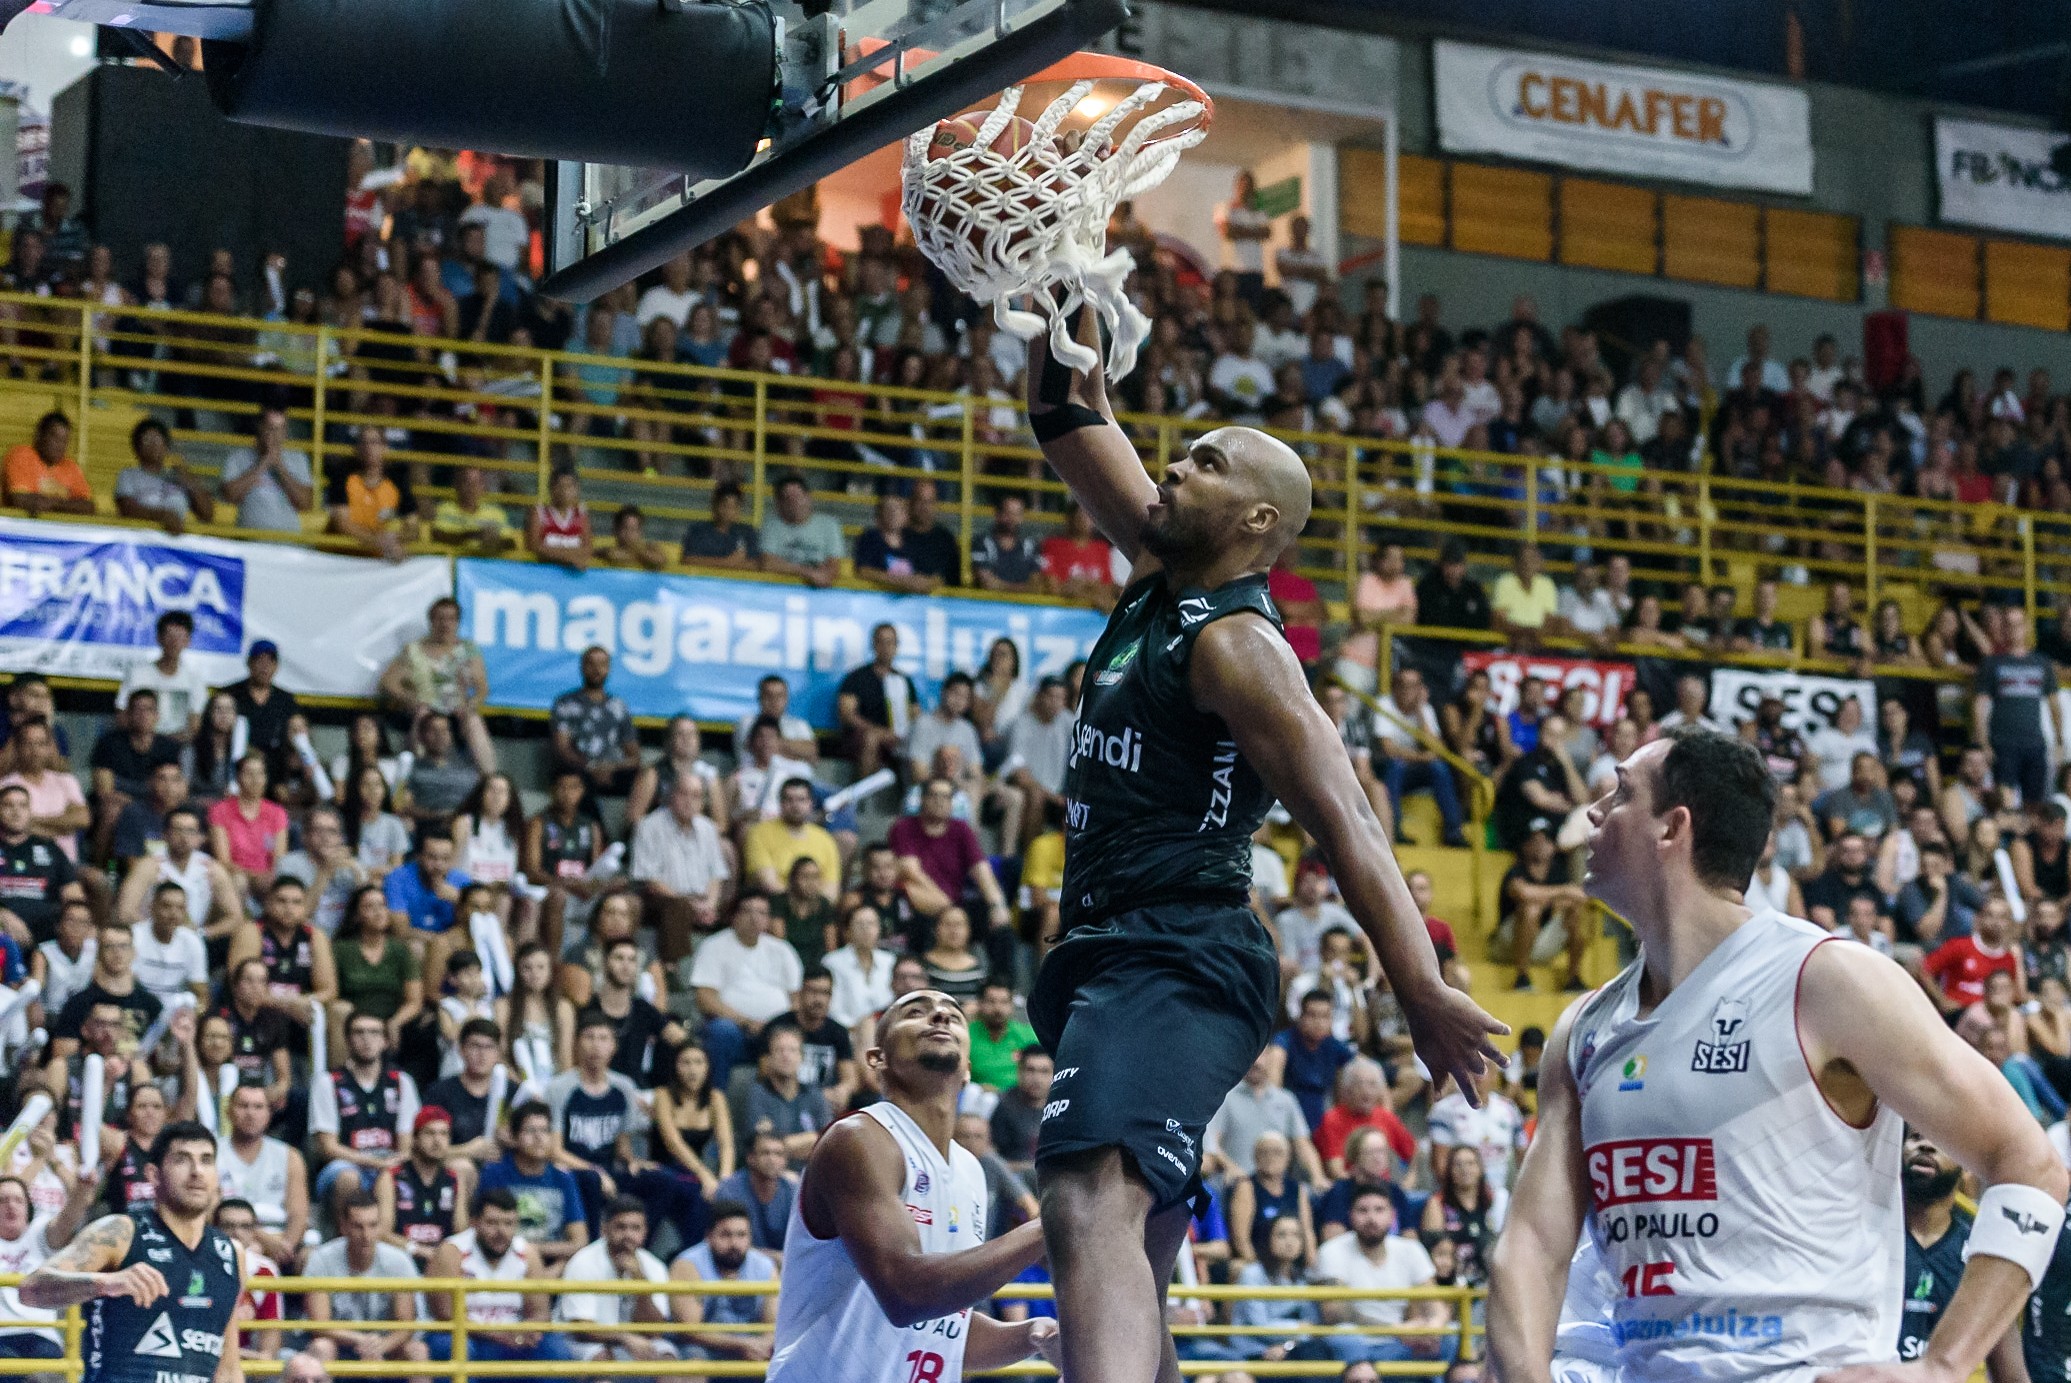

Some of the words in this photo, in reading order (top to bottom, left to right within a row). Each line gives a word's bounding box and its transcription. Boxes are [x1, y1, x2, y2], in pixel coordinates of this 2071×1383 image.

[1517, 71, 1727, 143] CENAFER
[0, 552, 228, 613] FRANCA
[474, 586, 1102, 681] magazineluiz
[1733, 684, 1858, 733] SES
[1694, 1042, 1748, 1070] SESI
[1040, 1099, 1070, 1124] ORP
[1588, 1144, 1698, 1202] SESI
[1634, 1212, 1719, 1240] PAULO
[905, 1349, 945, 1383] 18
